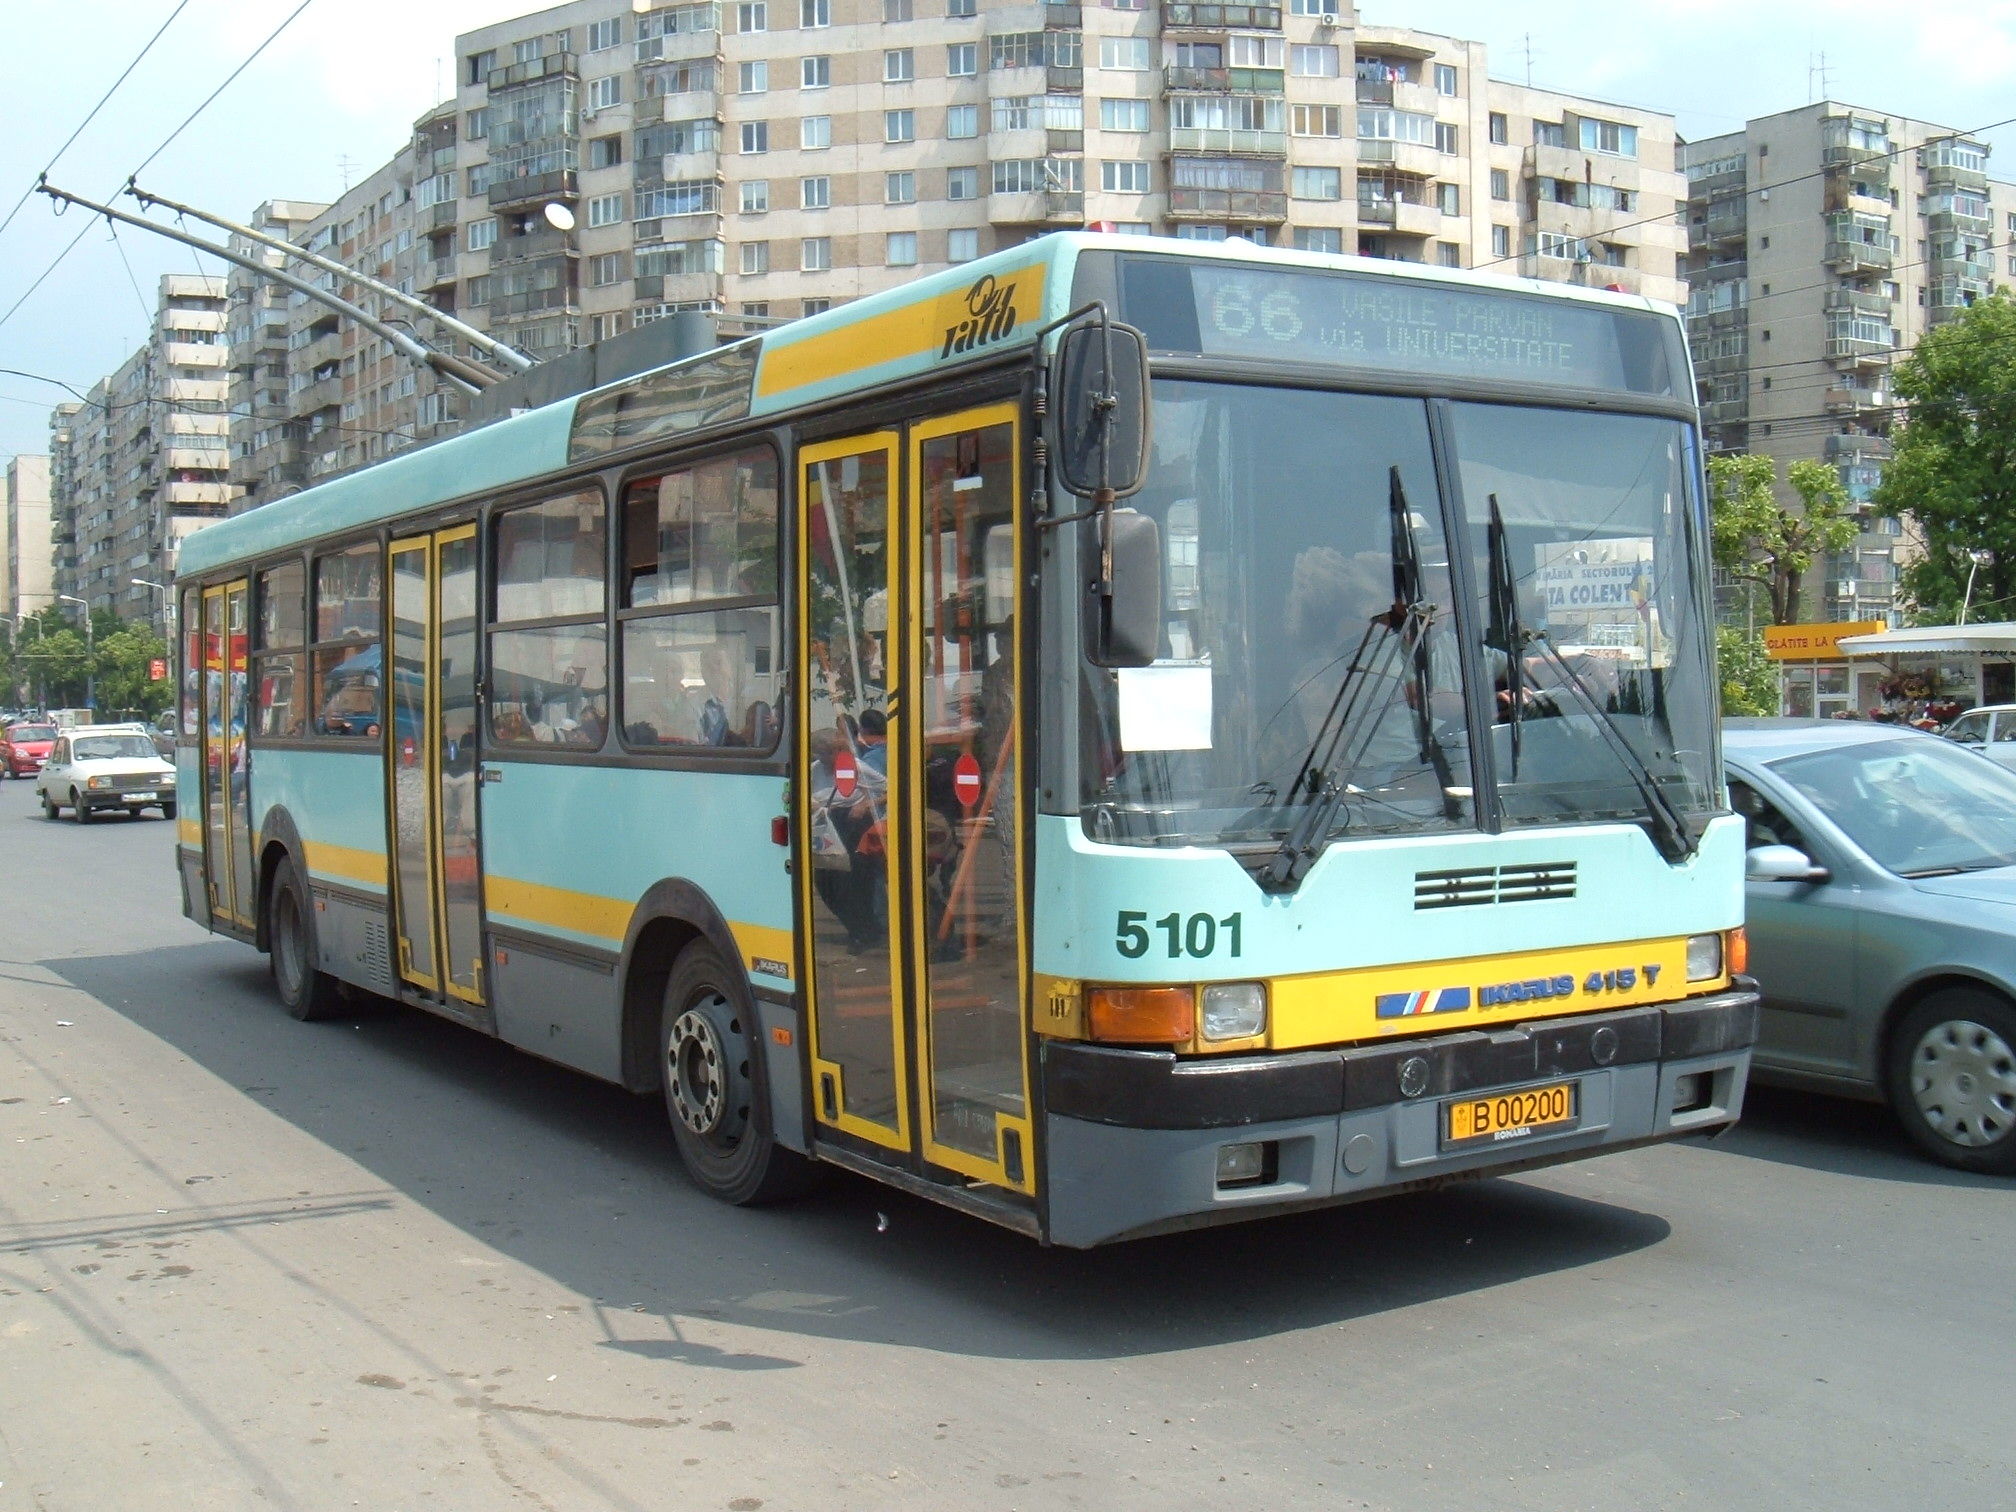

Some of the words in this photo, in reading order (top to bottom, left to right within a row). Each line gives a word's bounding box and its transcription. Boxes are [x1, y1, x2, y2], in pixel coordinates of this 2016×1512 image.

[1214, 284, 1303, 341] 66
[1341, 289, 1438, 327] VASILE
[1455, 300, 1552, 338] PARVAN
[1320, 321, 1367, 352] via
[1386, 326, 1574, 371] UNIVERSITATE
[1581, 563, 1642, 579] SECTORUL
[1115, 910, 1242, 959] 5101
[1479, 974, 1575, 1007] IKARUS
[1583, 967, 1637, 992] 415
[1642, 963, 1661, 986] T
[1474, 1102, 1490, 1133] B
[1496, 1088, 1565, 1128] 00200
